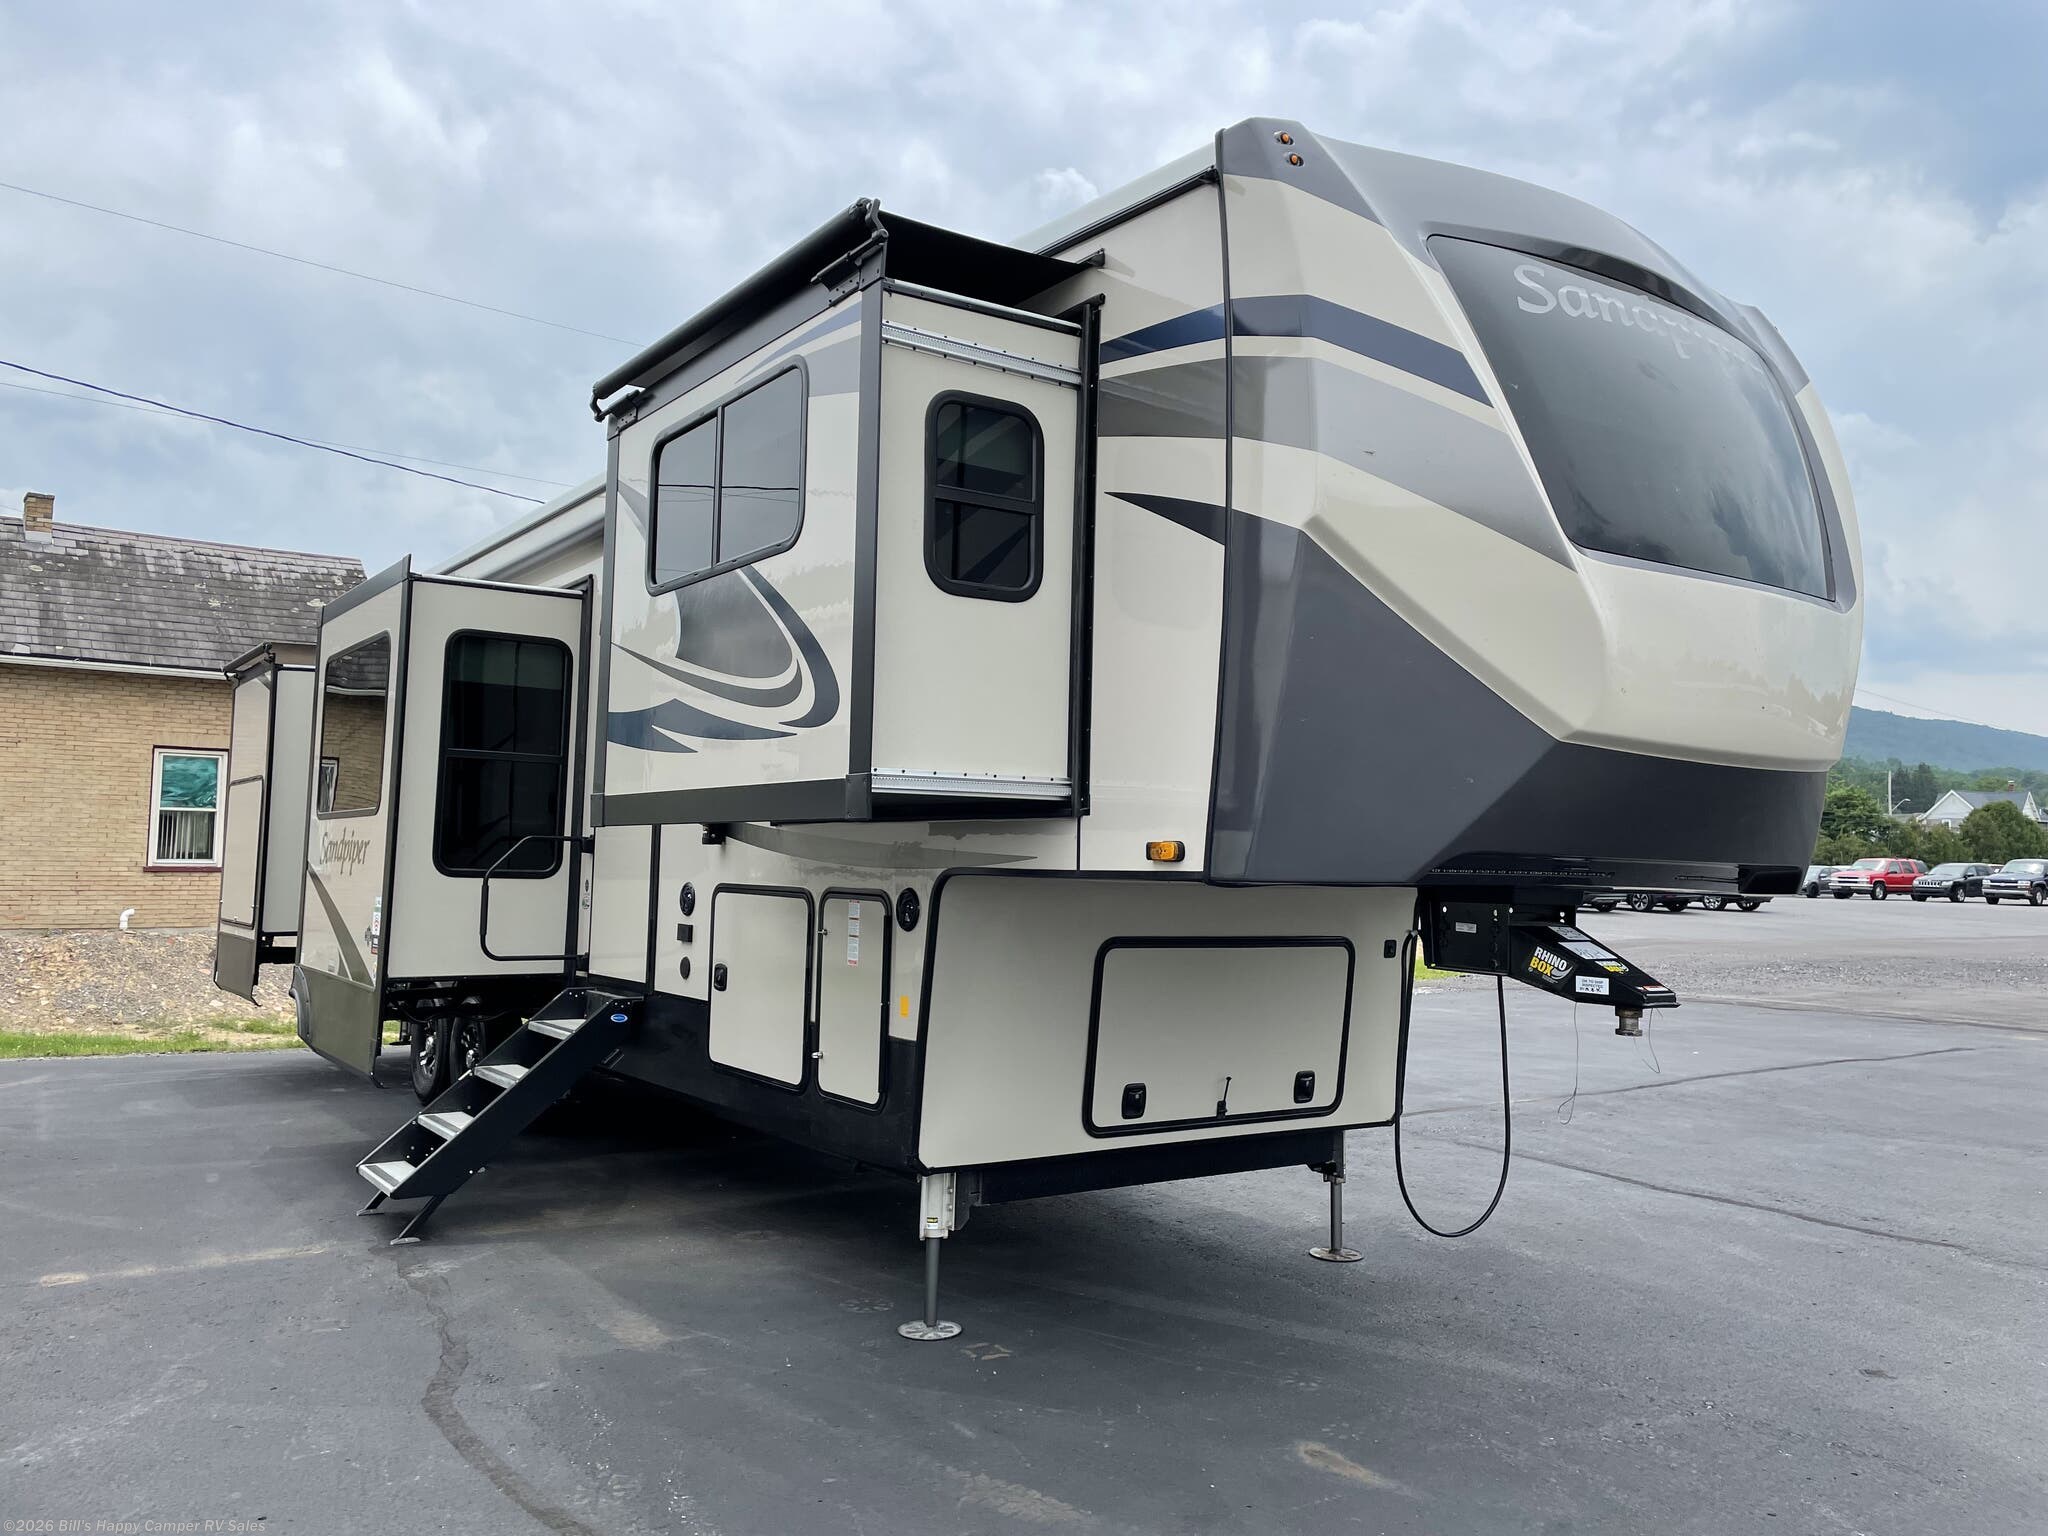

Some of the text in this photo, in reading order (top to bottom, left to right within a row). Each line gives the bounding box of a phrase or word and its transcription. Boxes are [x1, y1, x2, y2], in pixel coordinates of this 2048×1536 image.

[320, 826, 371, 876] Sandpiper
[1529, 956, 1553, 977] BOX
[1533, 946, 1567, 971] RHINO
